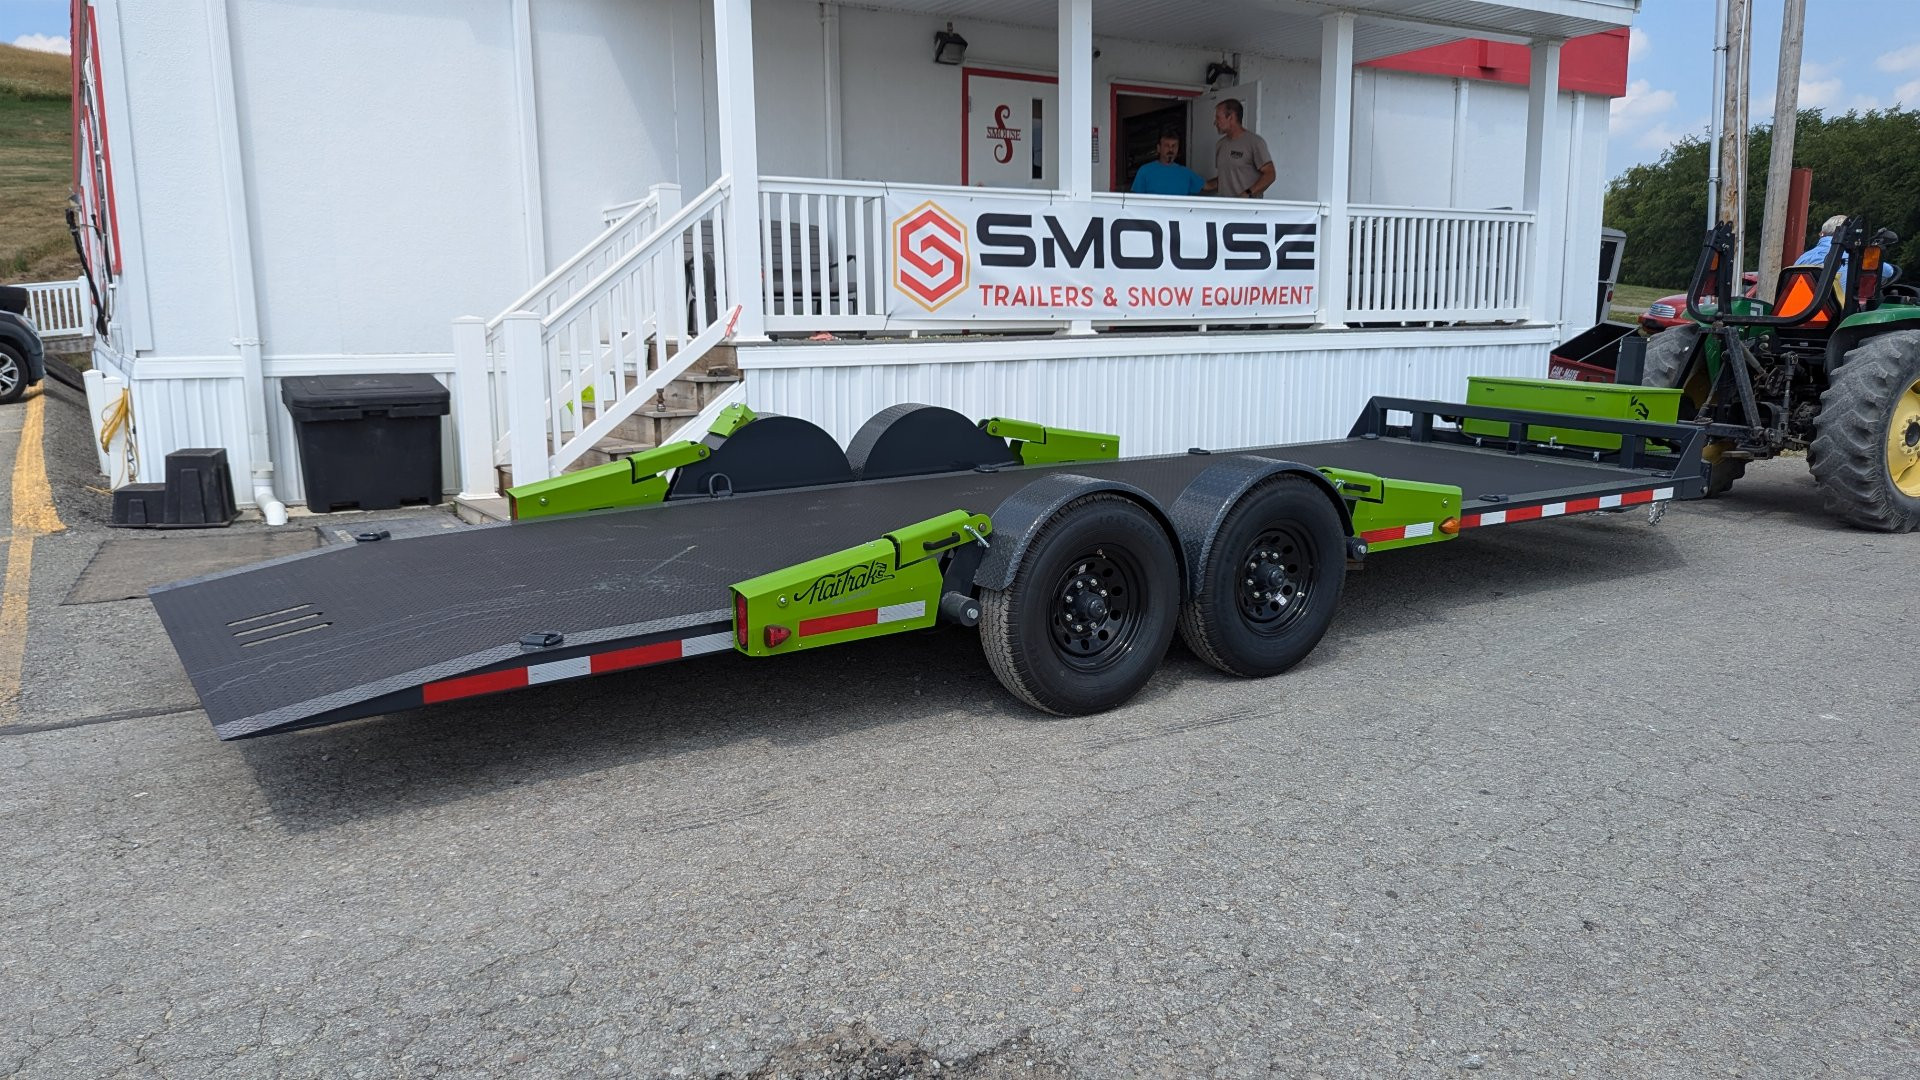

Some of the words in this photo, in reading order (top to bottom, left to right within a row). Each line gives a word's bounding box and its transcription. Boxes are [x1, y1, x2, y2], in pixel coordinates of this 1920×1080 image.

[987, 127, 1021, 141] SMOUSE
[976, 212, 1317, 271] SMOUSE
[979, 284, 1094, 307] TRAILERS
[1103, 286, 1118, 307] &
[1128, 286, 1194, 307] SNOW
[1202, 285, 1314, 306] EQUIPMENT
